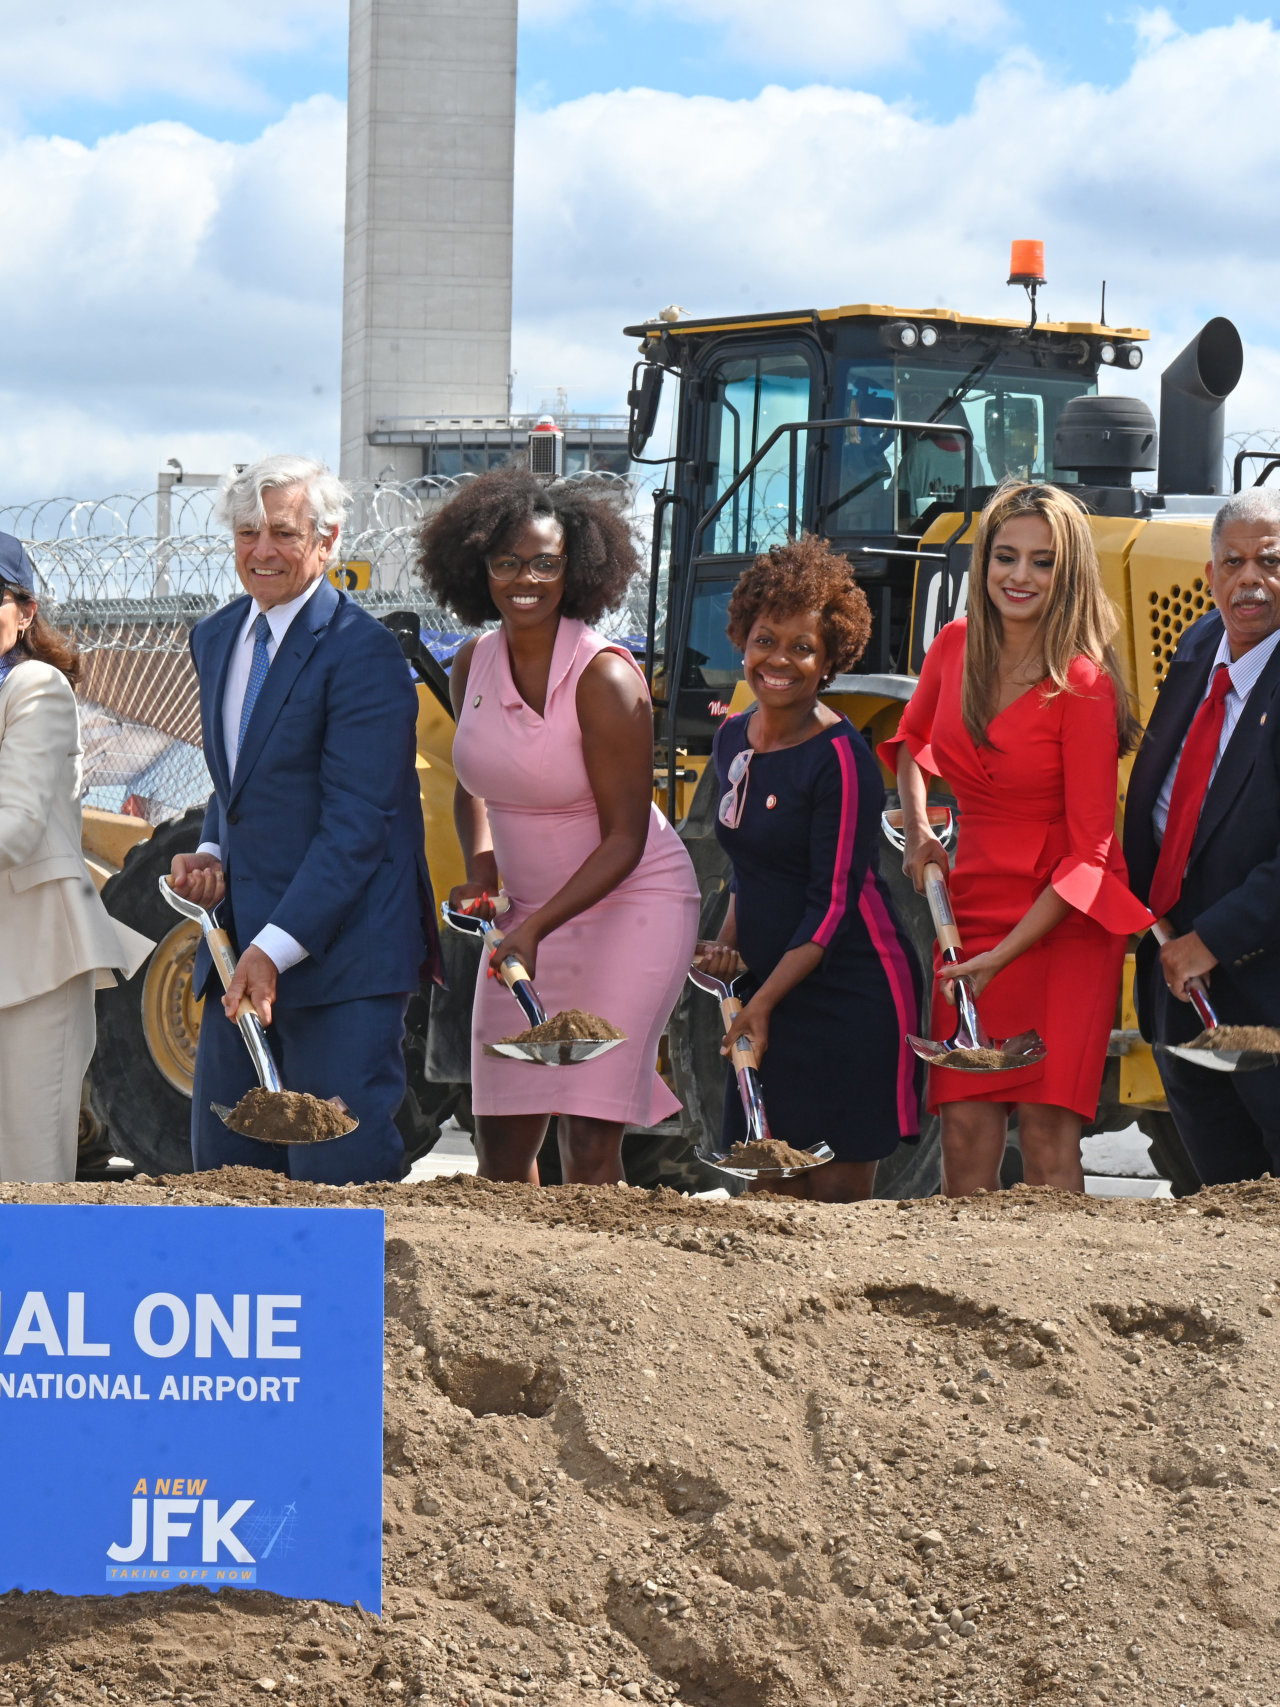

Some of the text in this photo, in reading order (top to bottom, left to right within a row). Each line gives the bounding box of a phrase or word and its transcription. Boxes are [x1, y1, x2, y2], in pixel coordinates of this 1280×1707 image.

[134, 1293, 302, 1359] ONE
[158, 1375, 301, 1402] AIRPORT
[132, 1478, 208, 1496] A NEW
[106, 1499, 257, 1563] JFK
[111, 1569, 253, 1581] TAKING OFF NOW
